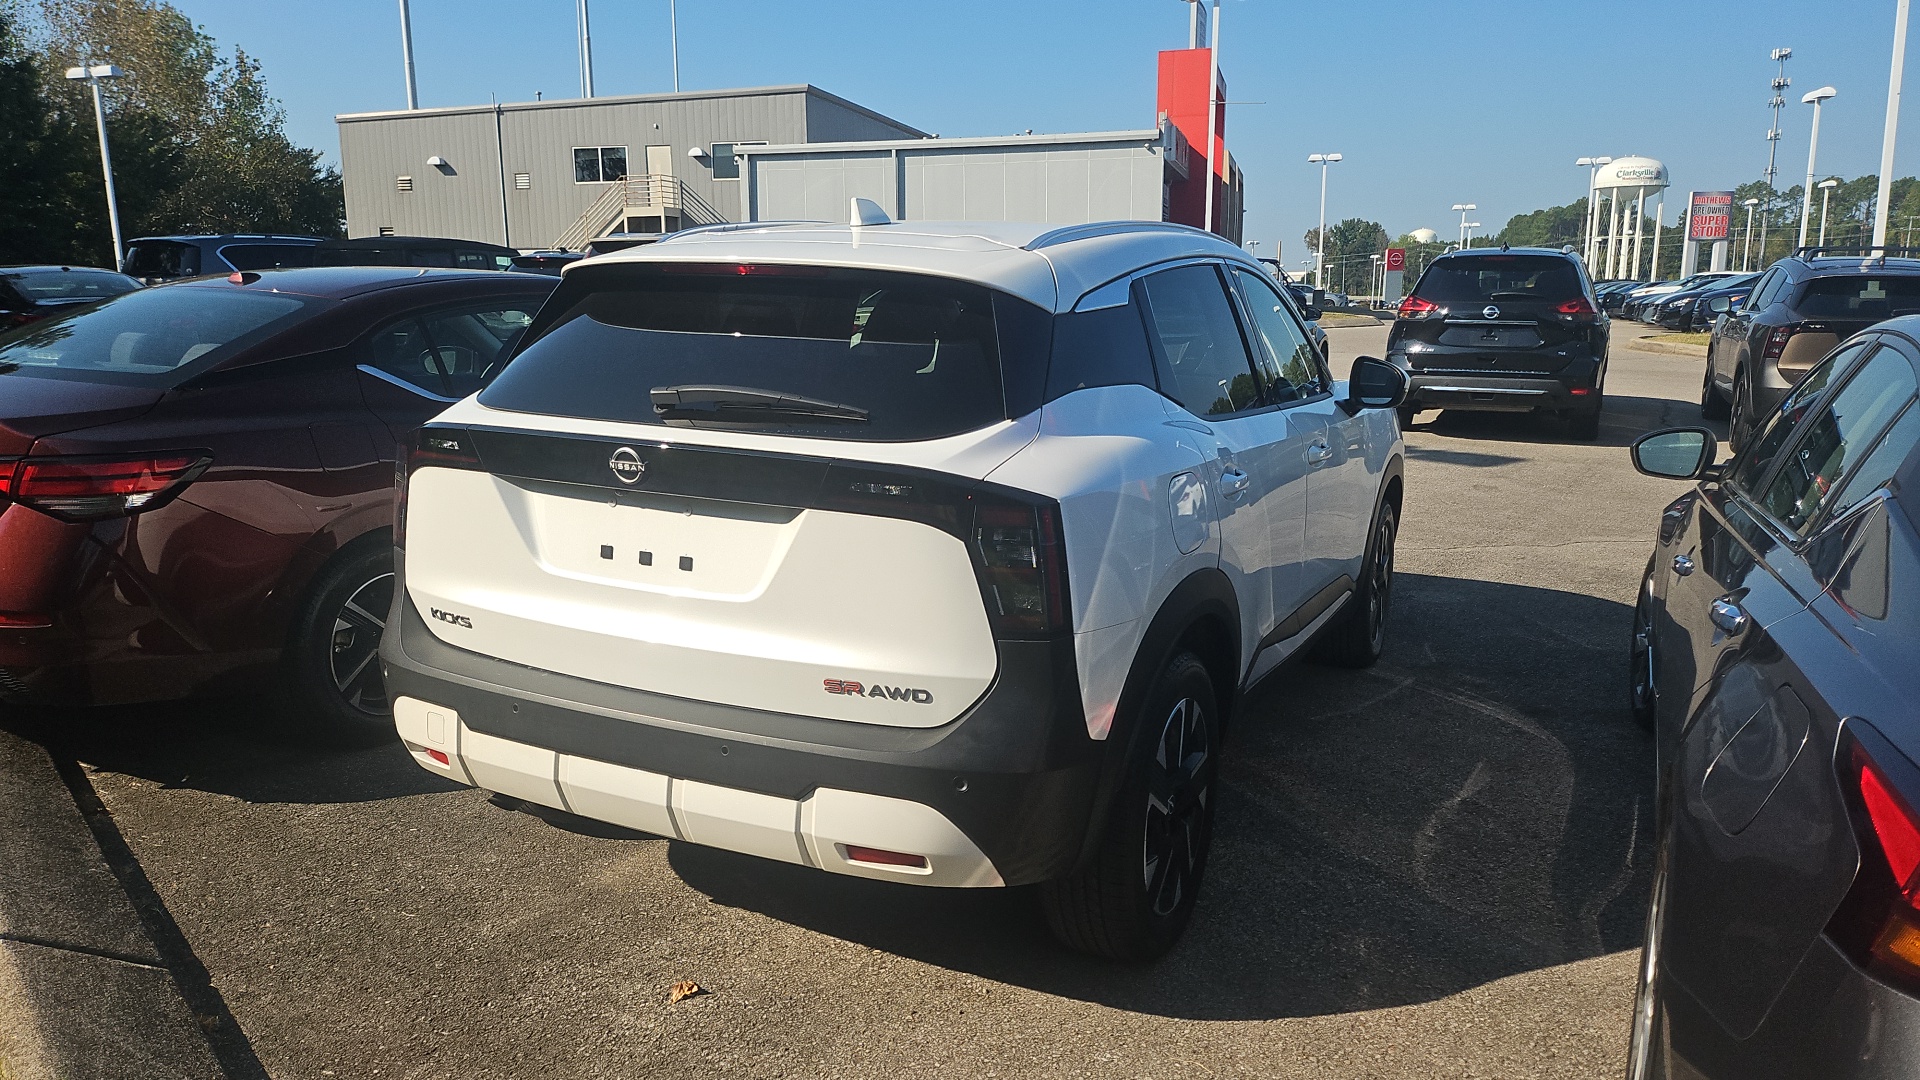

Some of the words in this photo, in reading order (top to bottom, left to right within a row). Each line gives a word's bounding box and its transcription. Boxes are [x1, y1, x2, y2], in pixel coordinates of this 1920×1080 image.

[1616, 169, 1654, 178] Clarksville
[1694, 196, 1731, 204] MATHEWS
[1693, 215, 1728, 225] SUPER
[1692, 226, 1727, 237] STORE
[609, 461, 645, 471] NISSAN
[431, 607, 472, 629] KICKS
[824, 679, 866, 697] SR
[868, 684, 933, 704] AWD
